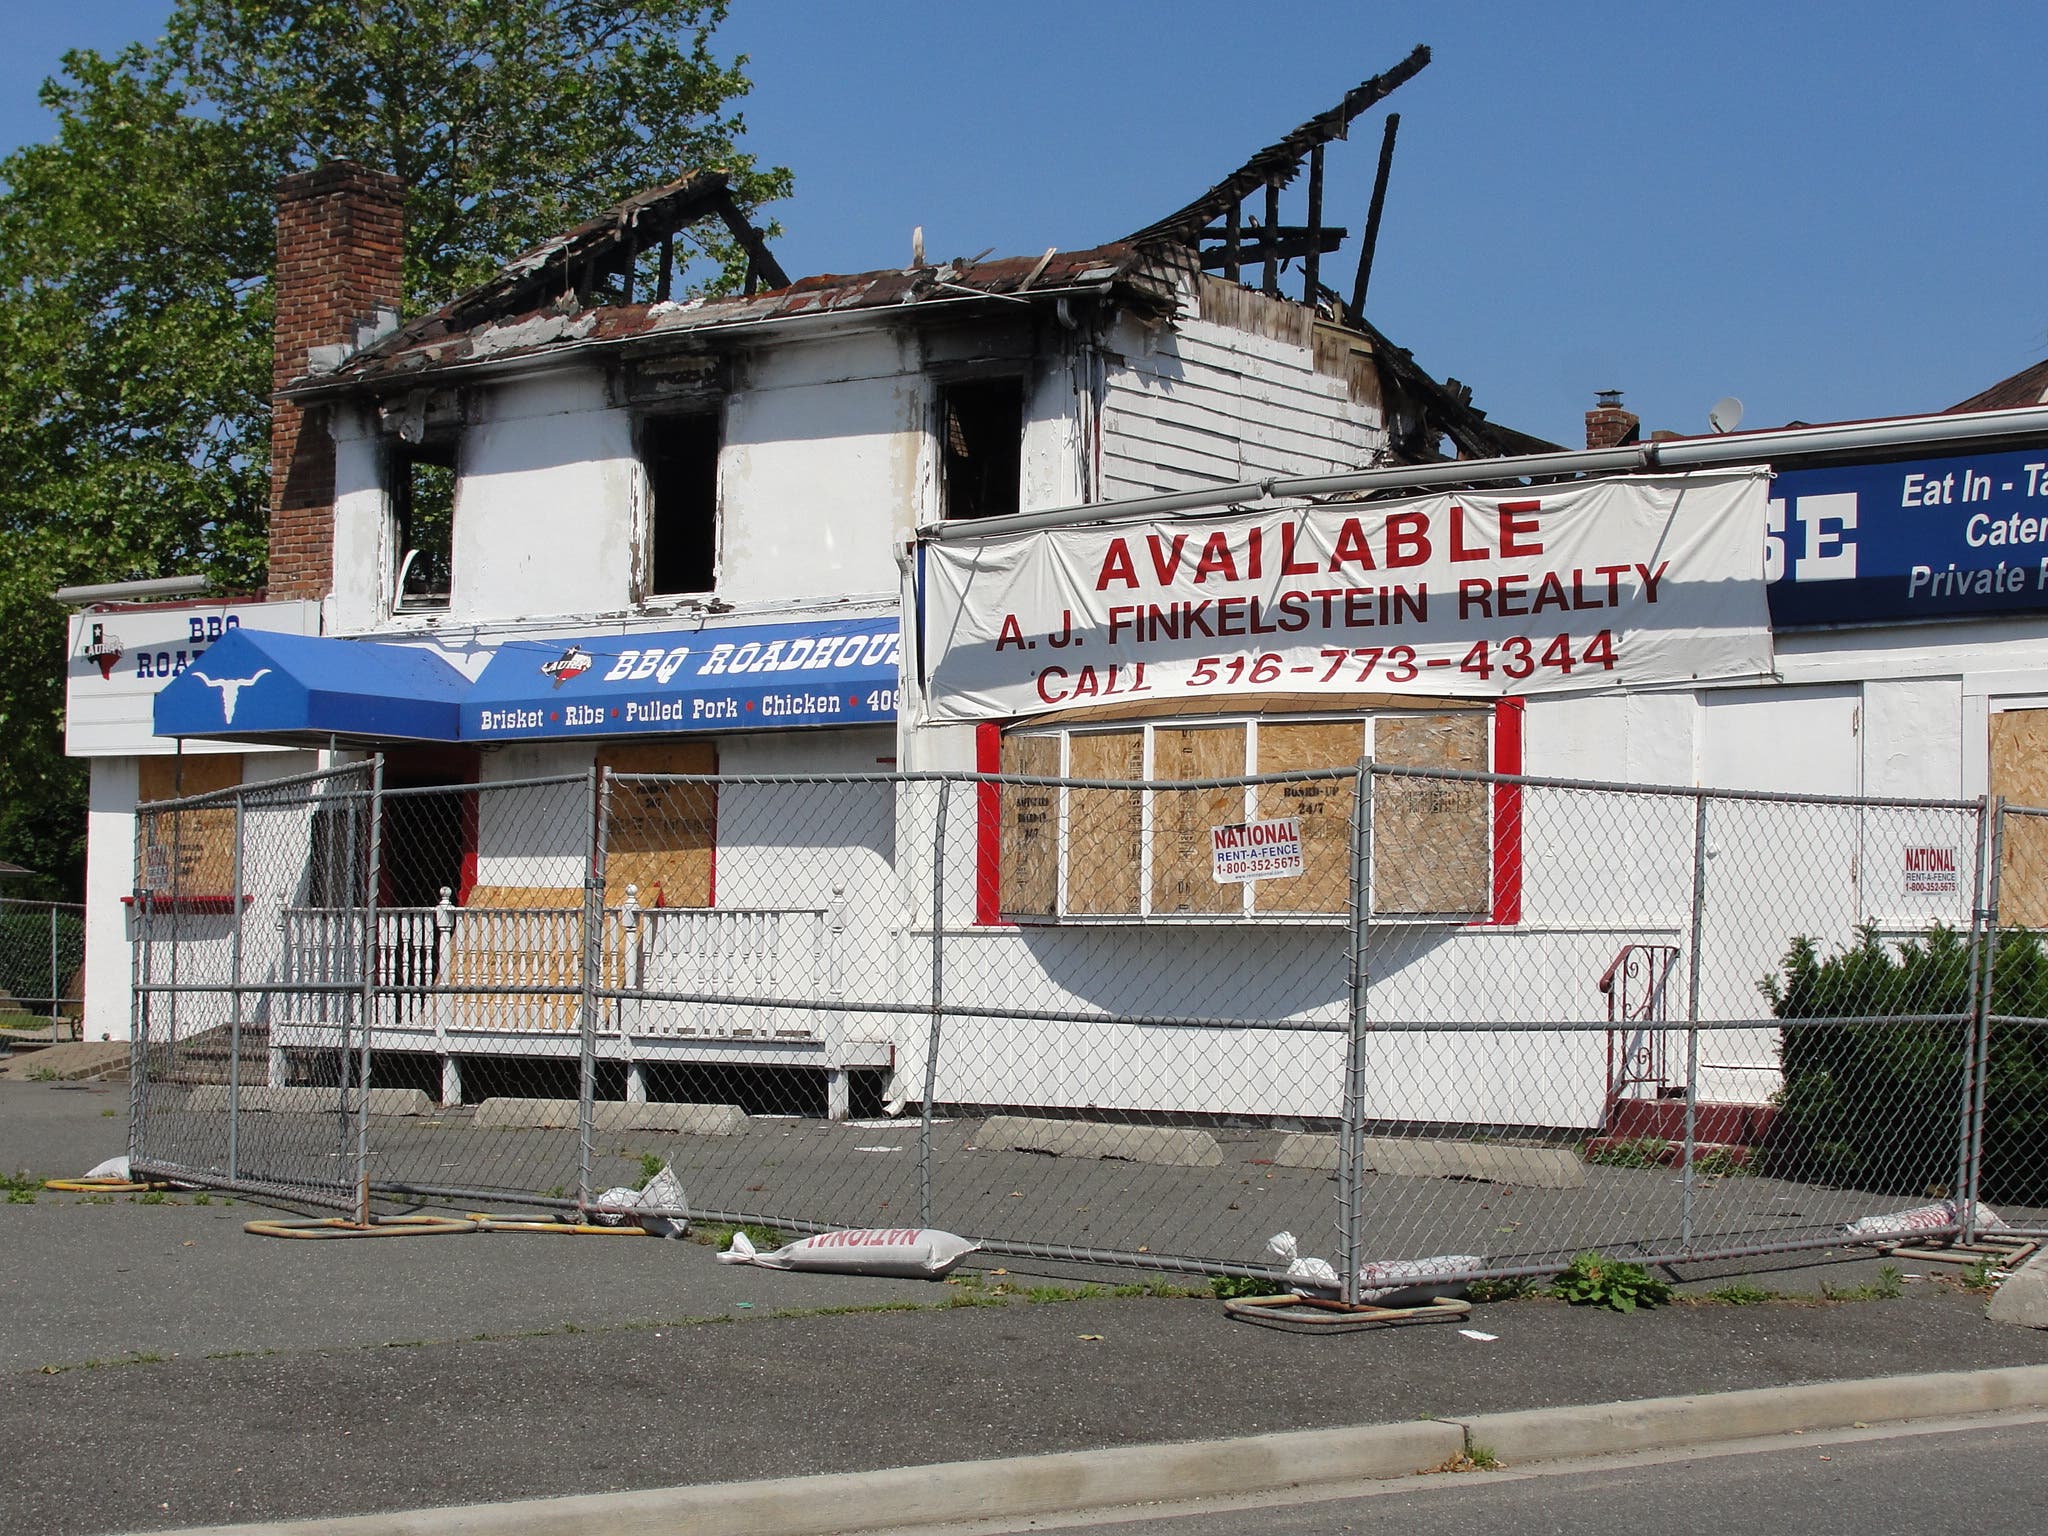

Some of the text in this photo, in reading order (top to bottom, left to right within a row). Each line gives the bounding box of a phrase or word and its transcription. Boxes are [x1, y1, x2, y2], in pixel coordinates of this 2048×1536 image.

[1901, 472, 1954, 507] Eat
[1962, 469, 1991, 503] In
[1095, 499, 1544, 591] AVAILABLE
[1908, 560, 2026, 598] Private
[996, 560, 1670, 652] A. J. FINKELSTEIN REALTY
[136, 650, 206, 679] ROA
[603, 647, 690, 684] BBQ
[1037, 629, 1619, 704] CALL 516-773-4344
[481, 708, 544, 731] Brisket
[565, 704, 605, 726] Ribs
[626, 698, 683, 722] Pulled
[692, 697, 738, 720] Pork
[762, 693, 841, 716] Chicken
[1214, 822, 1298, 850] NATIONAL
[1217, 843, 1299, 862] RENT-A-FENCE
[1216, 856, 1301, 875] 1-800-352-5675
[1905, 848, 1956, 872] NATIONAL
[1905, 873, 1956, 881] RENT-A-FENCE
[1905, 882, 1956, 891] 1-800-352-5675
